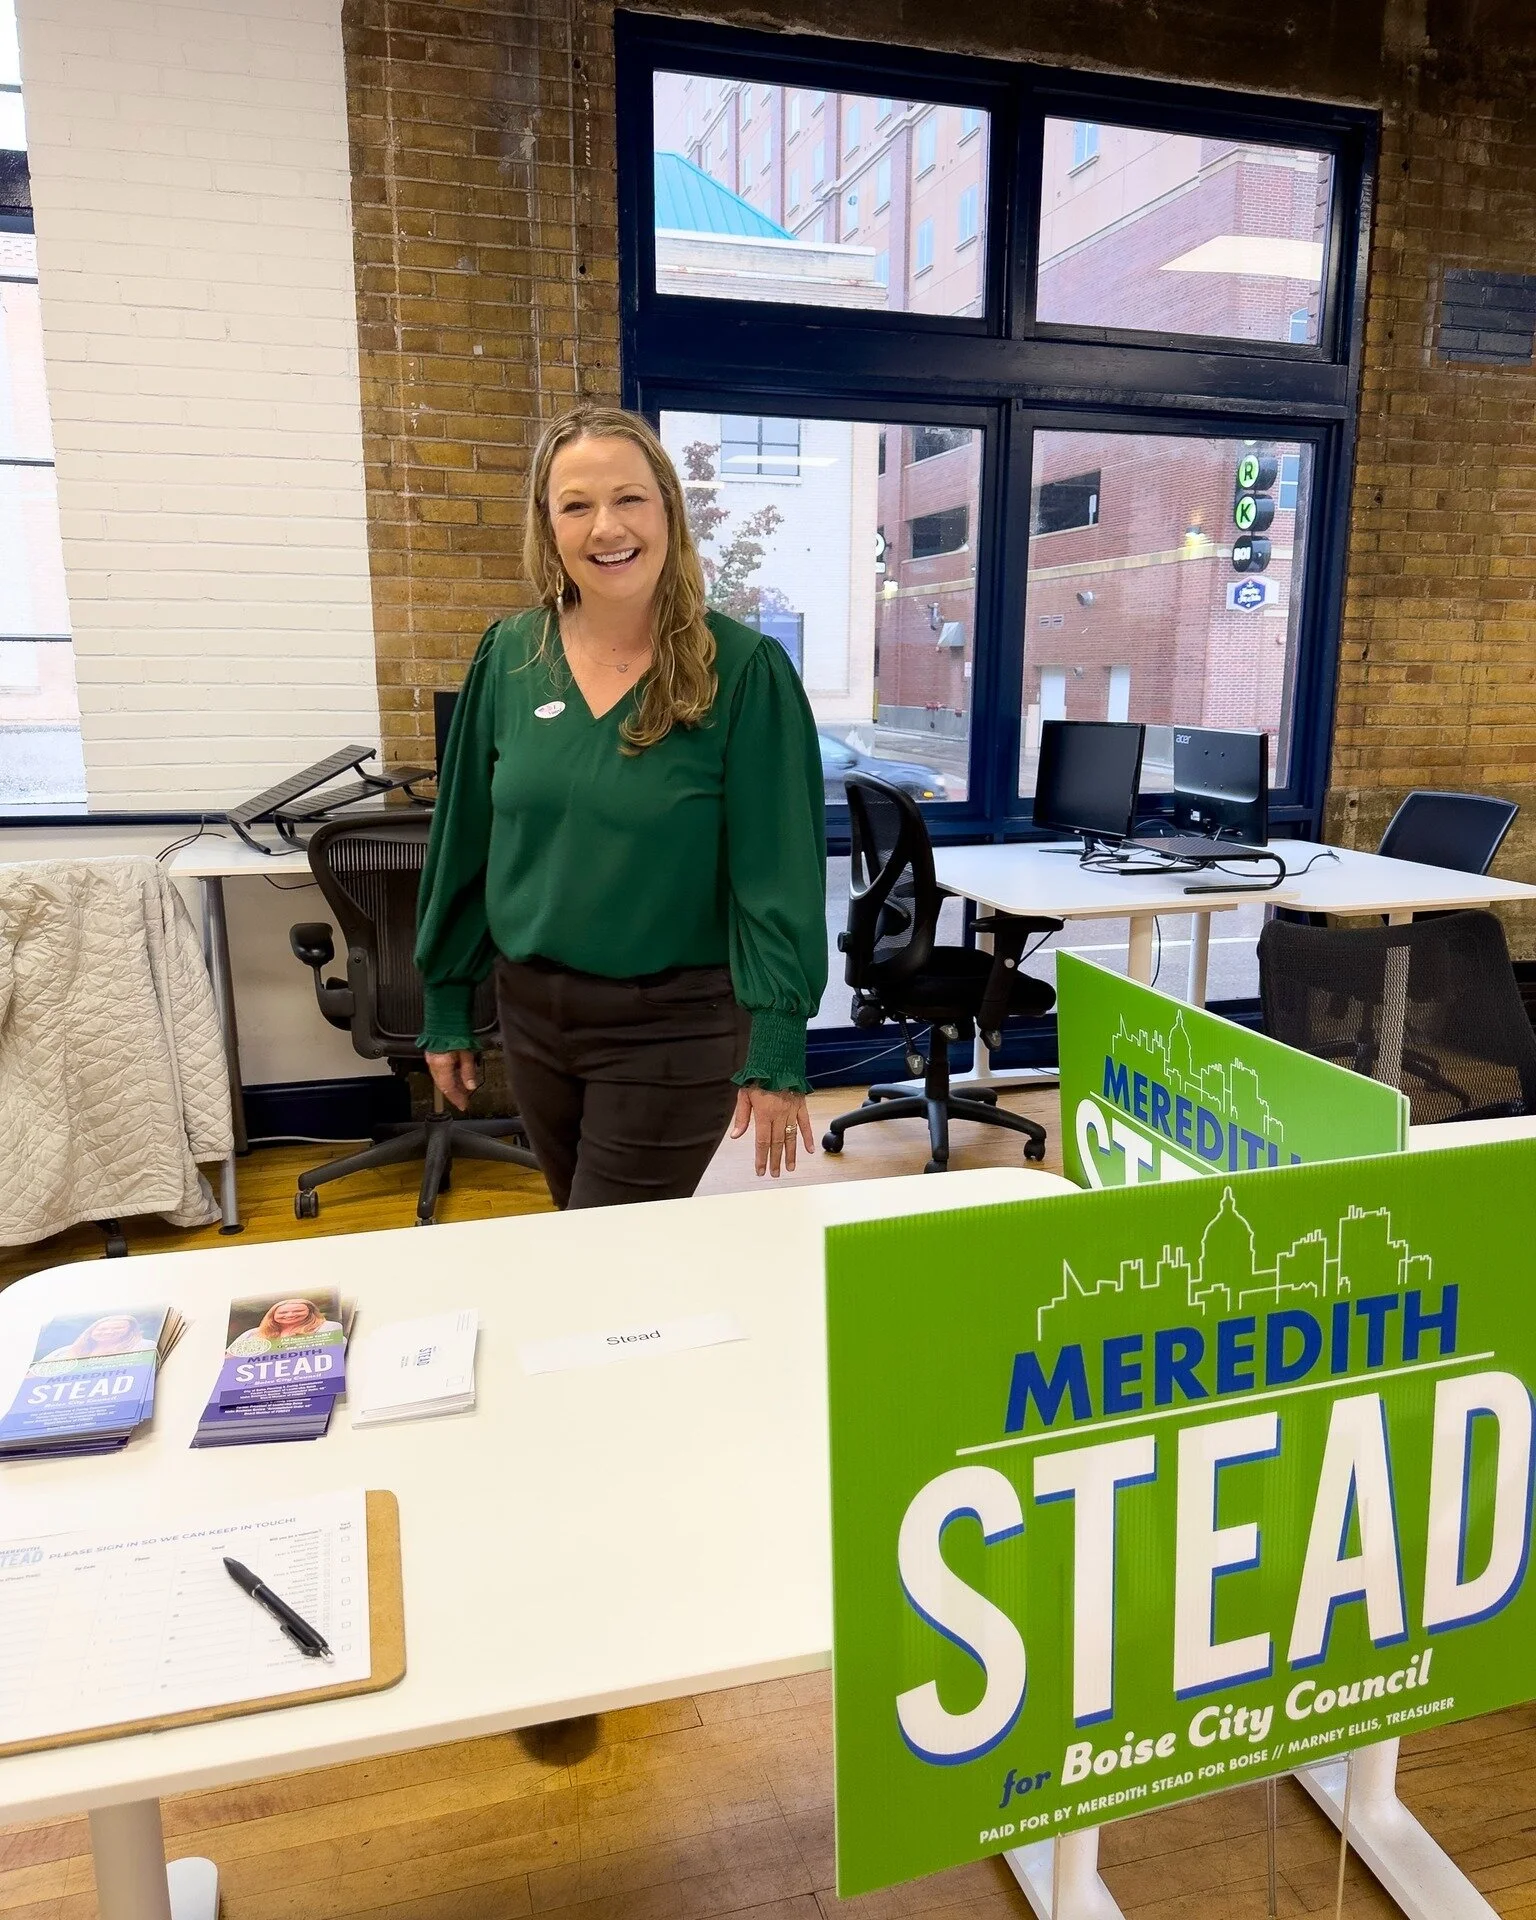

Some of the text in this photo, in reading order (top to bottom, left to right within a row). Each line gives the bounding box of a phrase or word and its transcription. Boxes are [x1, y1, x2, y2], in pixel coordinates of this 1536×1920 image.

[1175, 734, 1191, 744] acer
[606, 1330, 661, 1345] Stead
[235, 1354, 333, 1382] STEAD
[248, 1348, 323, 1363] MEREDITH
[1004, 1284, 1459, 1433] MEREDITH
[46, 1368, 127, 1383] MEREDITH
[27, 1376, 134, 1405] STEAD
[48, 1547, 93, 1560] PLEASE
[96, 1543, 124, 1552] SIGN
[160, 1534, 179, 1542] WE
[182, 1531, 206, 1539] CAN
[208, 1526, 239, 1536] KEEP
[256, 1517, 296, 1528] TOUCH!
[0, 1551, 43, 1567] TEAD
[897, 1371, 1536, 1767] STEAD
[999, 1648, 1433, 1809] for Boise City Council
[979, 1697, 1455, 1844] PAID FOR BY MEREDITH STEAD FOR BOISE // MARNEY ELLIS, TREASURER
